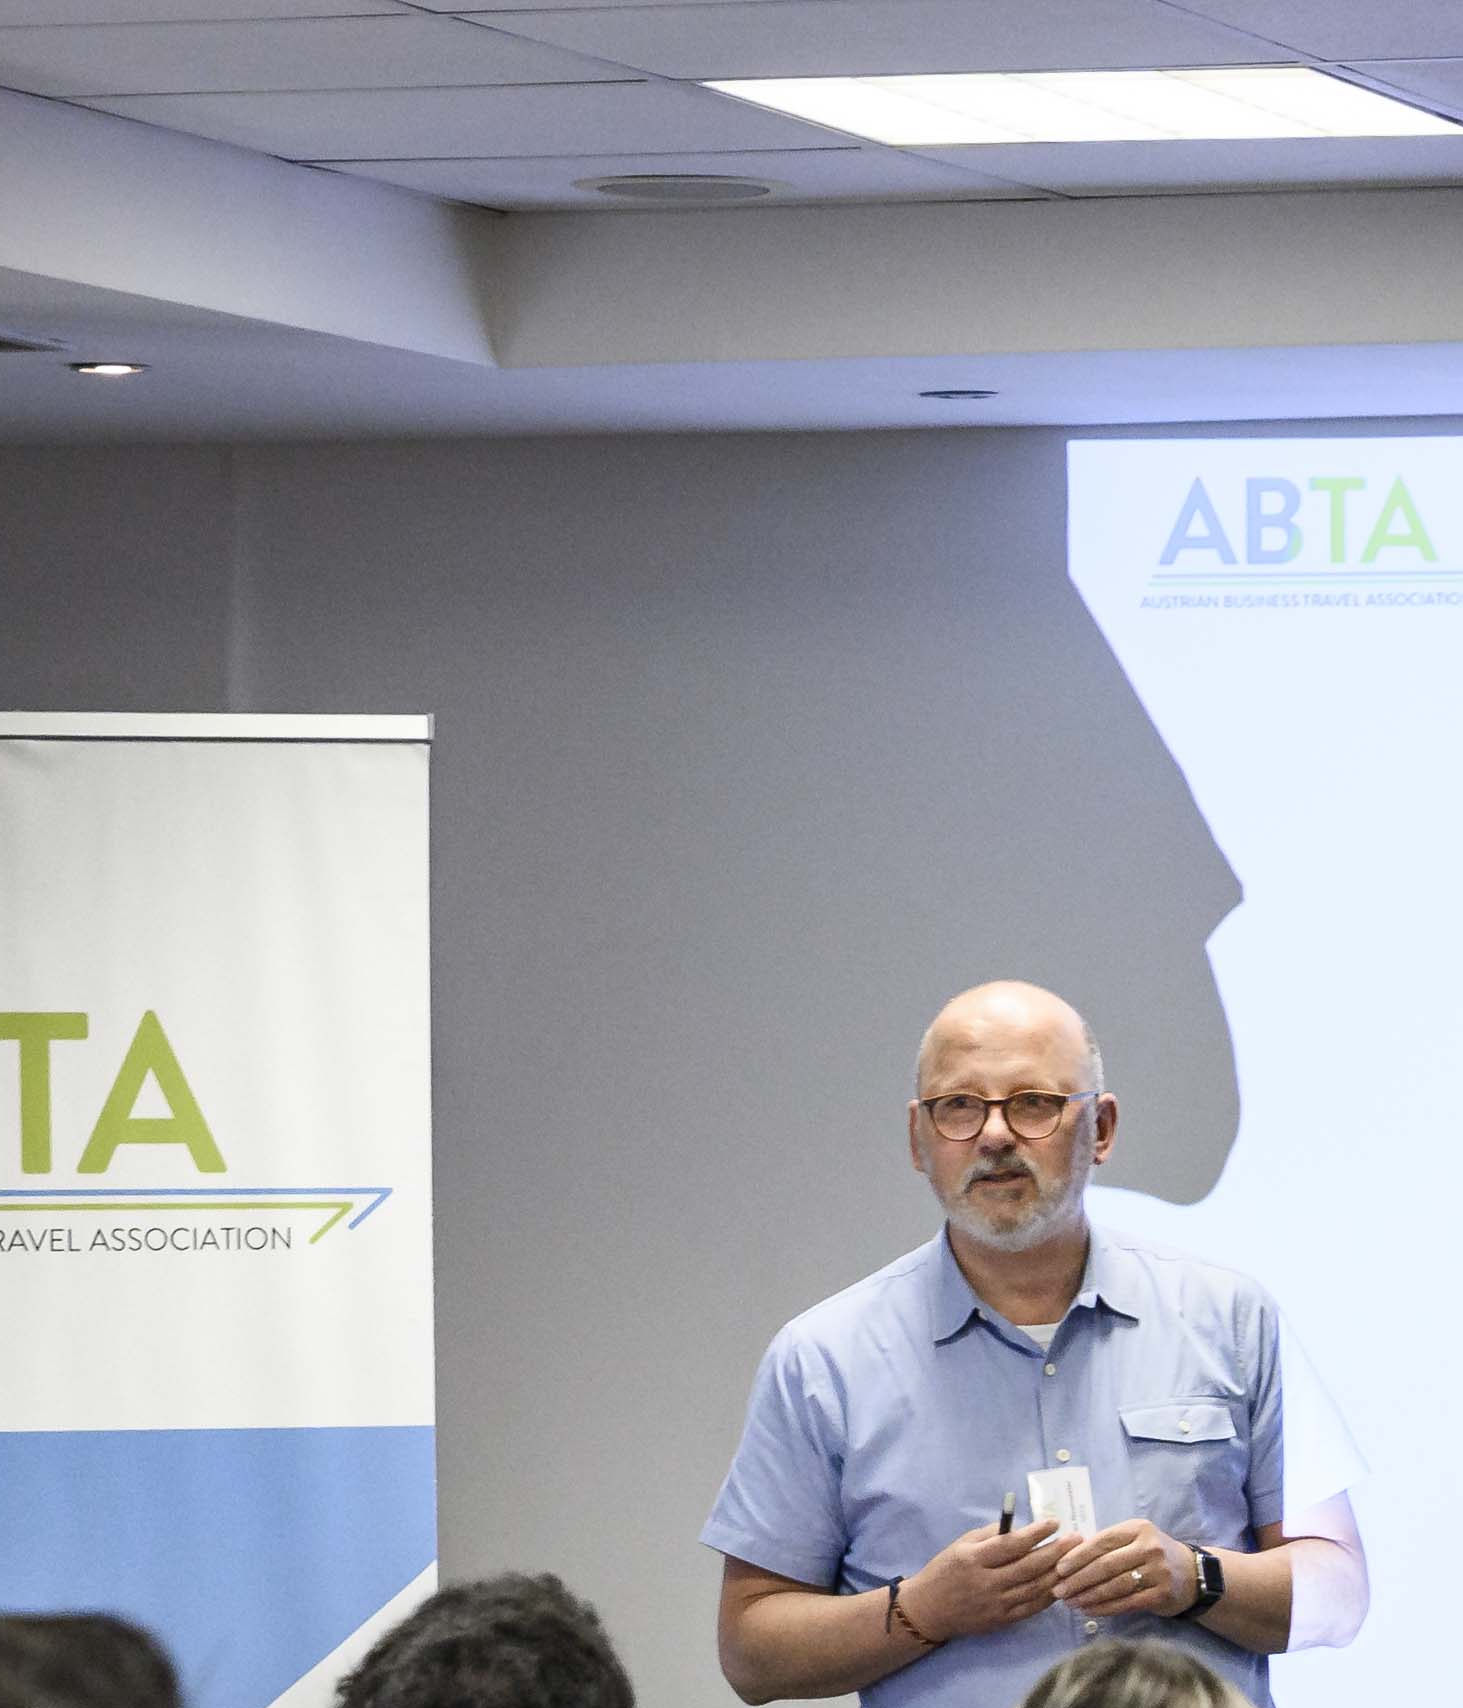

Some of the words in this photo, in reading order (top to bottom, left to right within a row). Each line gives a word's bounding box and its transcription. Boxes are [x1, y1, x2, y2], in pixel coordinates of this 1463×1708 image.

[1158, 474, 1439, 567] ABTA
[1139, 594, 1220, 609] AUSTRIAN
[1223, 593, 1300, 608] BUSINESS
[1302, 592, 1360, 608] TRAVEL
[89, 1226, 292, 1252] ASSOCIATION
